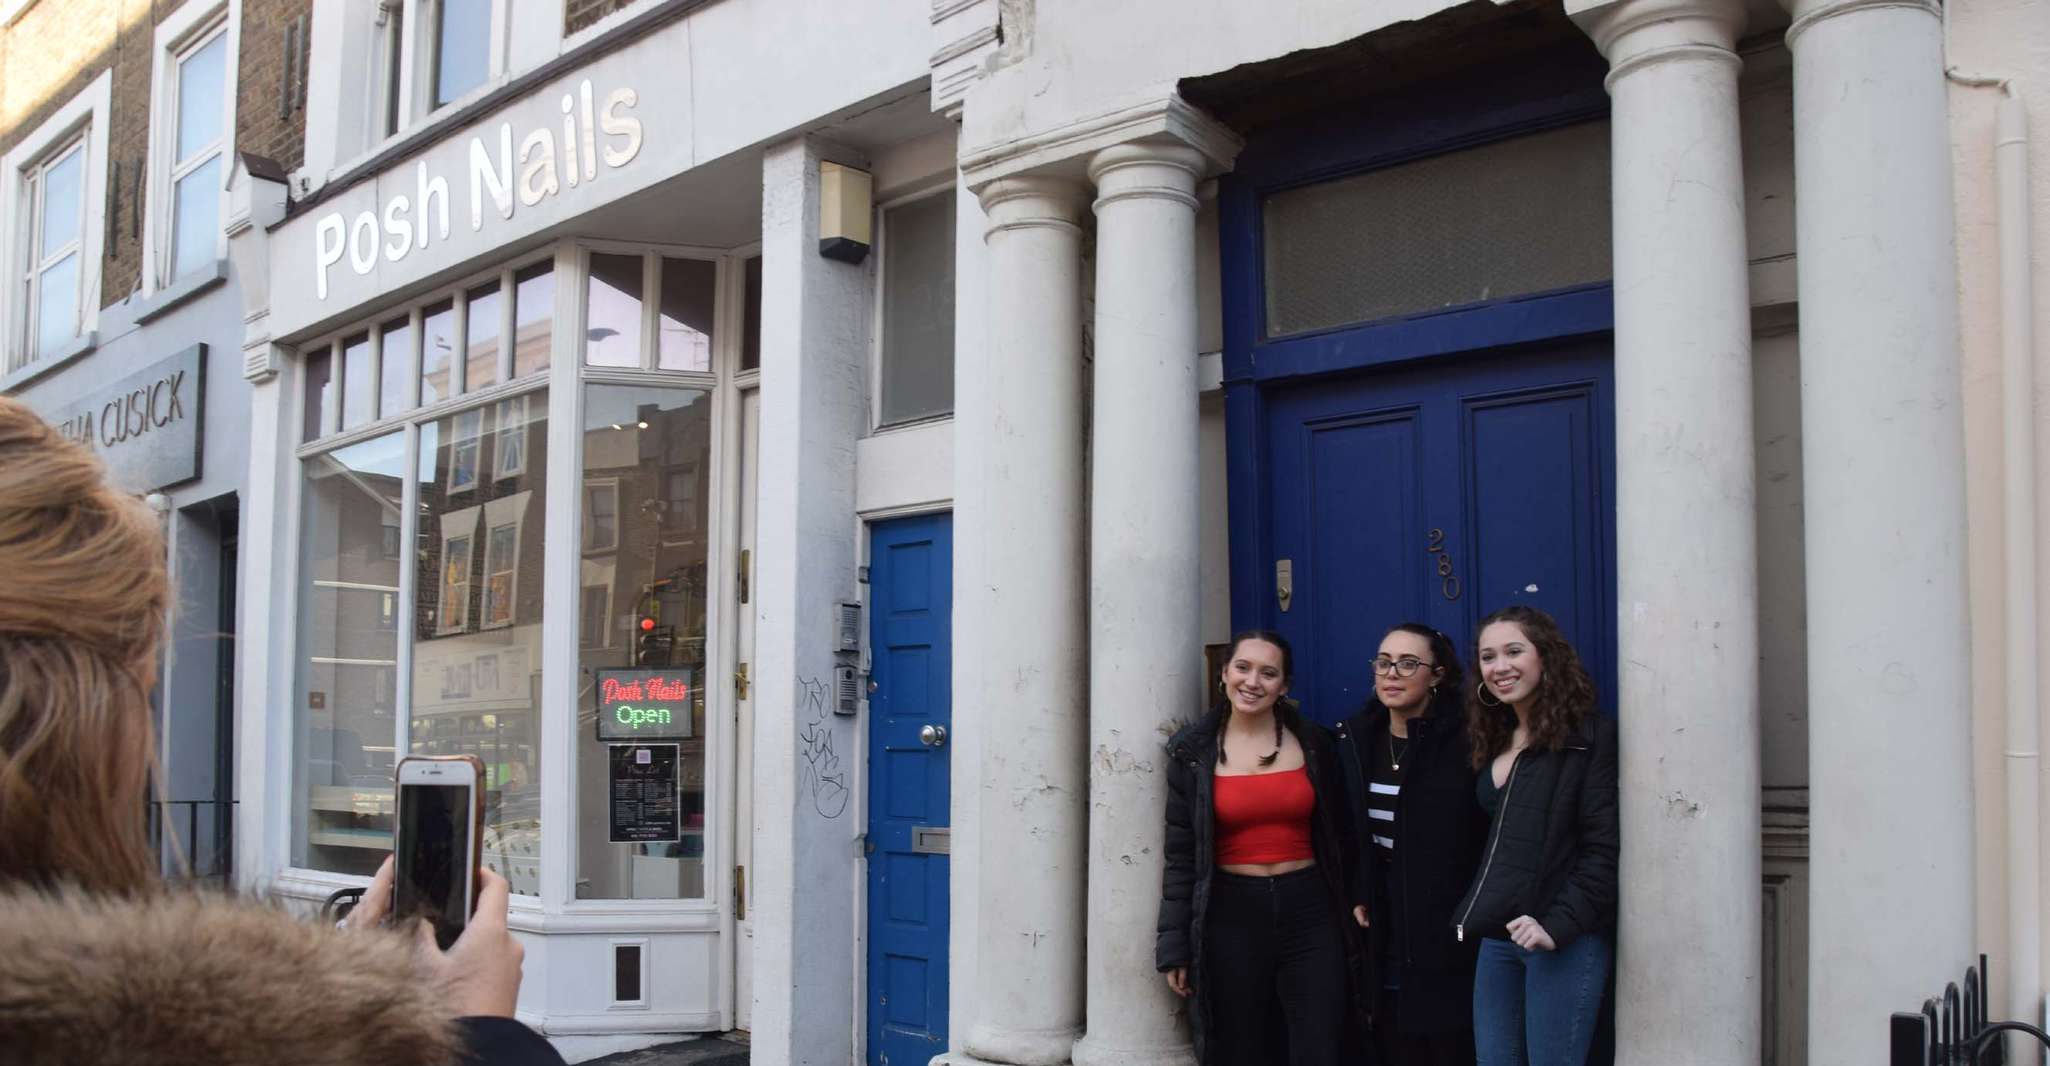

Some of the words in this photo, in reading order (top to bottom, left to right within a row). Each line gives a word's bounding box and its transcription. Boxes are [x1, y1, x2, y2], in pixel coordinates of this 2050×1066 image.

[315, 161, 450, 301] Posh
[470, 78, 643, 232] Nails
[101, 370, 184, 447] CUSICK
[1424, 527, 1461, 600] 280
[616, 705, 671, 729] Open
